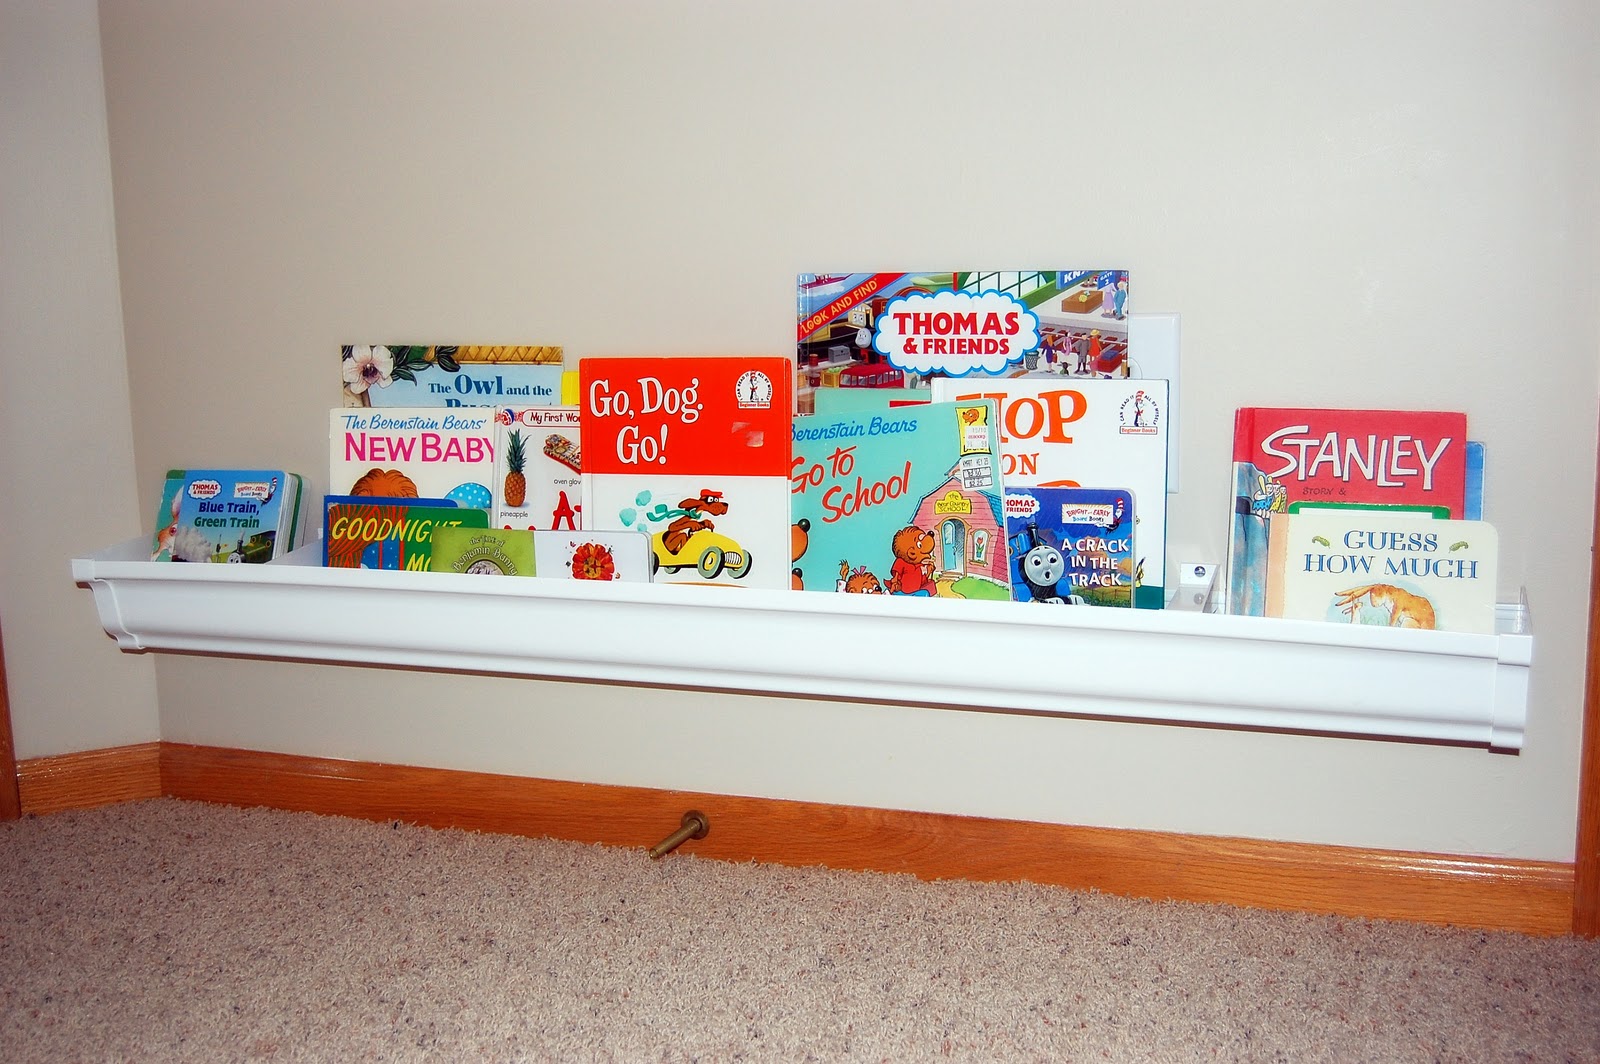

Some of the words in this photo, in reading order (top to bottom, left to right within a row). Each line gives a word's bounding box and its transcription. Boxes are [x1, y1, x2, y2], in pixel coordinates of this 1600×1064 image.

[802, 310, 829, 334] LOOK
[830, 296, 852, 316] AND
[853, 280, 878, 300] FIND
[893, 312, 1020, 335] THOMAS
[903, 338, 918, 354] &
[923, 338, 1010, 355] FRIENDS
[428, 382, 452, 394] The
[454, 374, 503, 394] Owl
[506, 386, 530, 396] and
[533, 386, 552, 396] the
[589, 378, 635, 420] Go,
[637, 376, 704, 424] Dog.
[341, 415, 366, 430] The
[370, 414, 439, 430] Berenstain
[442, 414, 487, 430] Bears'
[530, 412, 542, 424] My
[544, 412, 563, 422] First
[868, 416, 918, 436] Bears
[345, 432, 417, 461] NEW
[616, 423, 669, 465] Go!
[1261, 425, 1451, 490] STANLEY
[792, 456, 824, 494] Go
[826, 445, 857, 478] to
[822, 460, 912, 523] School
[1302, 486, 1334, 495] STORY
[1338, 488, 1346, 496] &
[199, 502, 224, 512] Blue
[227, 500, 260, 516] Train,
[500, 511, 528, 519] pineapple
[1066, 508, 1088, 517] BRIGHT
[194, 516, 226, 528] Green
[230, 516, 260, 528] Train
[1062, 538, 1072, 550] A
[1076, 538, 1130, 553] CRACK
[1343, 530, 1438, 552] GUESS
[453, 546, 490, 571] Benjamin
[492, 547, 518, 575] Bunny
[1070, 556, 1086, 568] IN
[1090, 558, 1118, 570] THE
[1303, 554, 1376, 574] HOW
[1384, 557, 1478, 579] MUCH
[1068, 572, 1122, 586] TRACK
